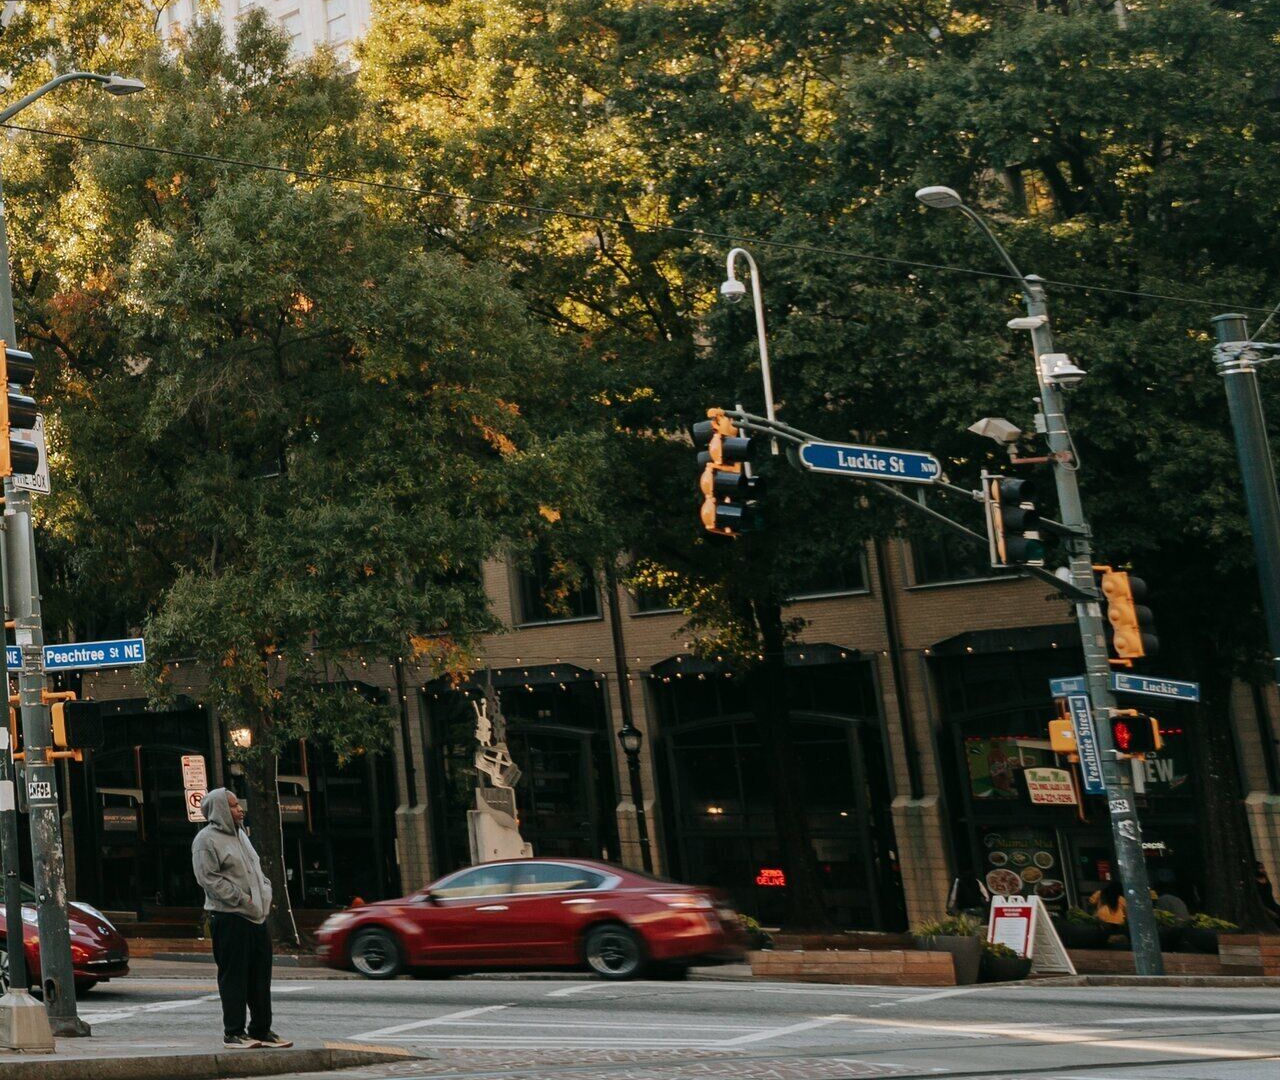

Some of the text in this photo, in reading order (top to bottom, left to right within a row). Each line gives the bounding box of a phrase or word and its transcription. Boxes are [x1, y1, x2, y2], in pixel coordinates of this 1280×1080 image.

[837, 450, 937, 473] Luckie St NW
[32, 474, 46, 488] BOX
[6, 650, 19, 664] NE
[46, 644, 141, 664] Peachtree St NE
[1142, 680, 1179, 695] Luckie
[1078, 709, 1090, 737] Street
[1083, 738, 1100, 782] Peachtree
